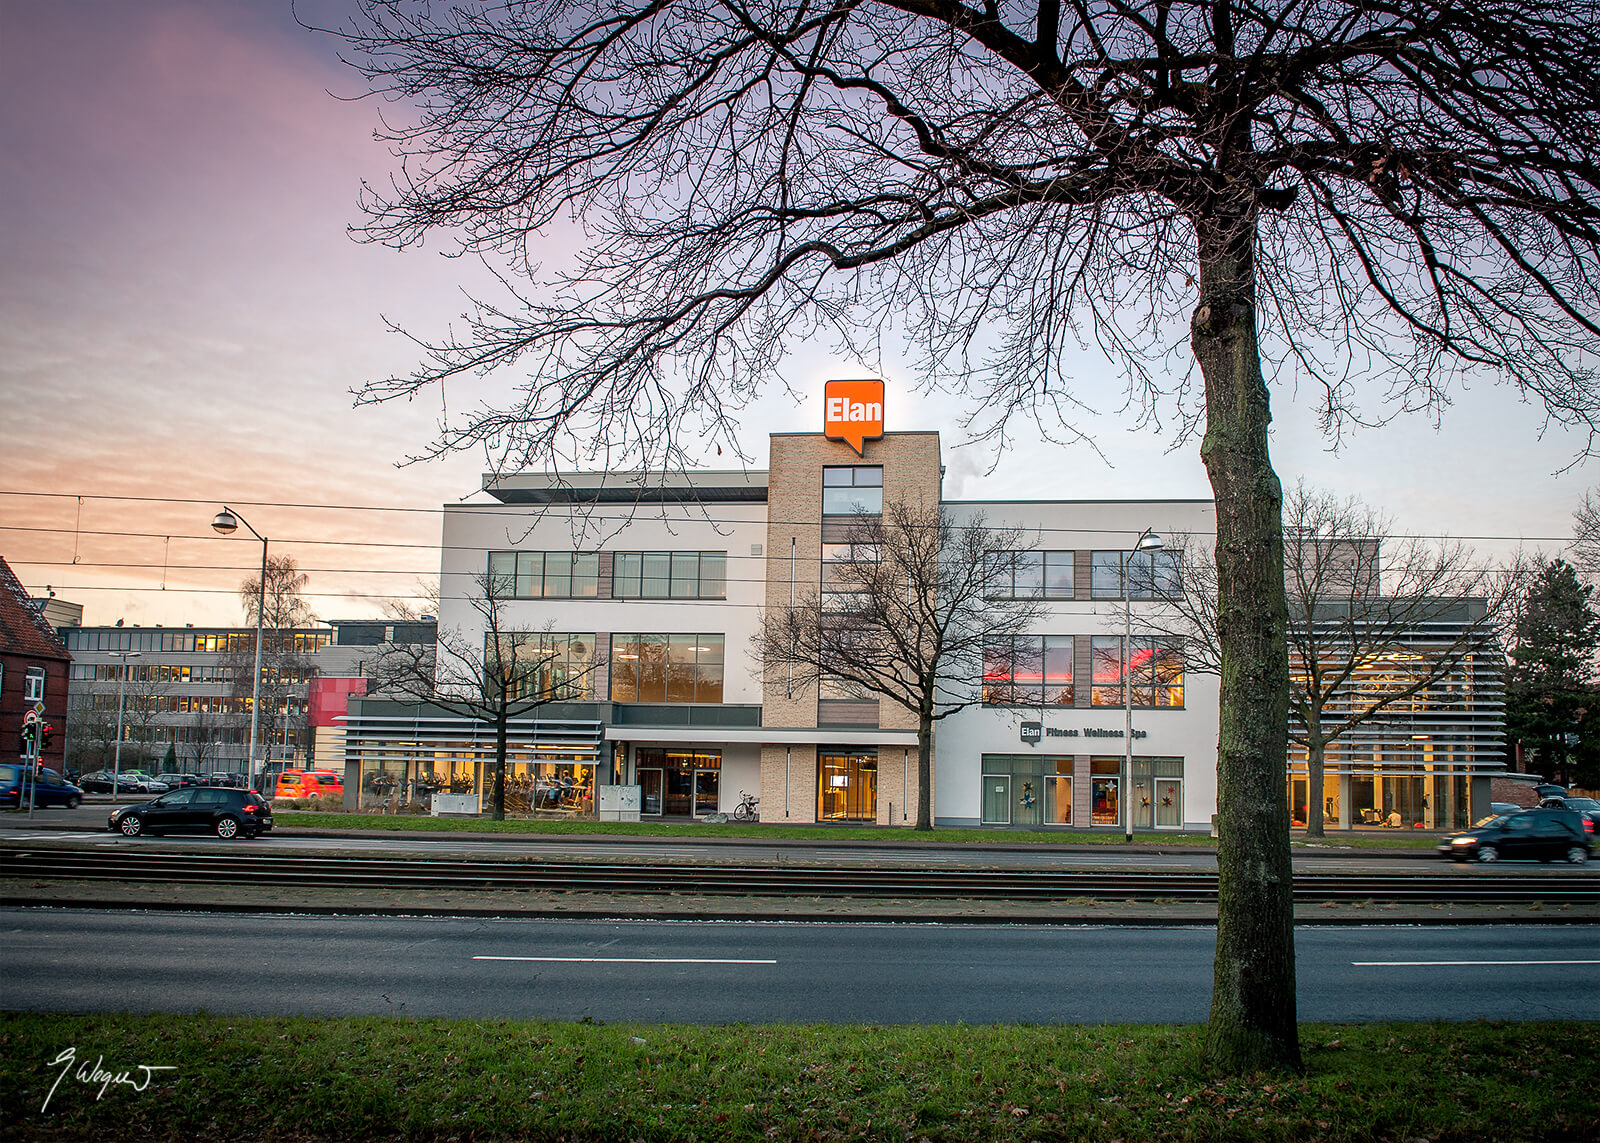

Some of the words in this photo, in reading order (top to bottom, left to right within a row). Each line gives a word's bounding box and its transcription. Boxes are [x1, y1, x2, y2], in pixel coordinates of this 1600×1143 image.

[827, 397, 882, 422] Elan
[1021, 727, 1041, 737] Elan
[1046, 727, 1079, 737] Fitness
[1083, 727, 1124, 738] Wellness
[1130, 728, 1147, 740] Spa
